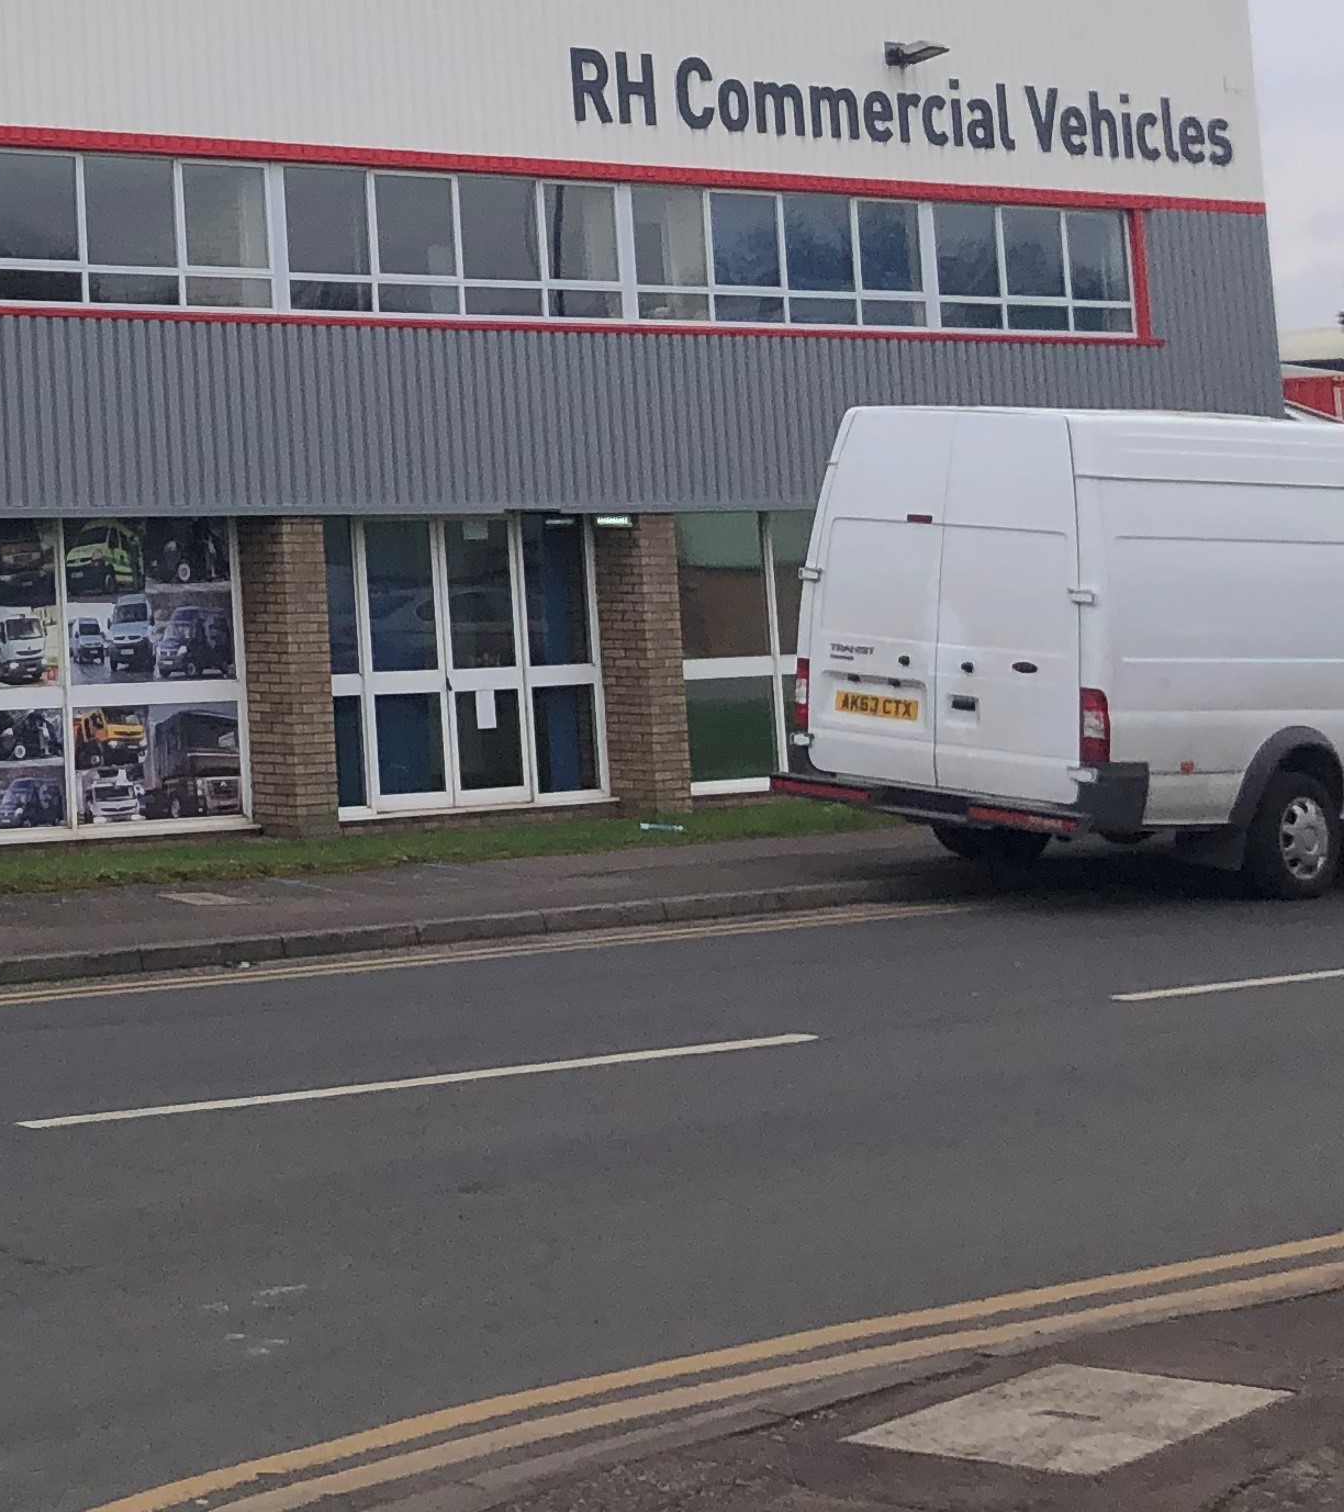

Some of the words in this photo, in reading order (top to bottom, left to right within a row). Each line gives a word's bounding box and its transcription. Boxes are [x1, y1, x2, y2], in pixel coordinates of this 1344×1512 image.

[570, 46, 658, 127] RH
[674, 56, 1017, 152] Commercial
[1024, 84, 1234, 168] Vehicles
[882, 699, 912, 717] CTX
